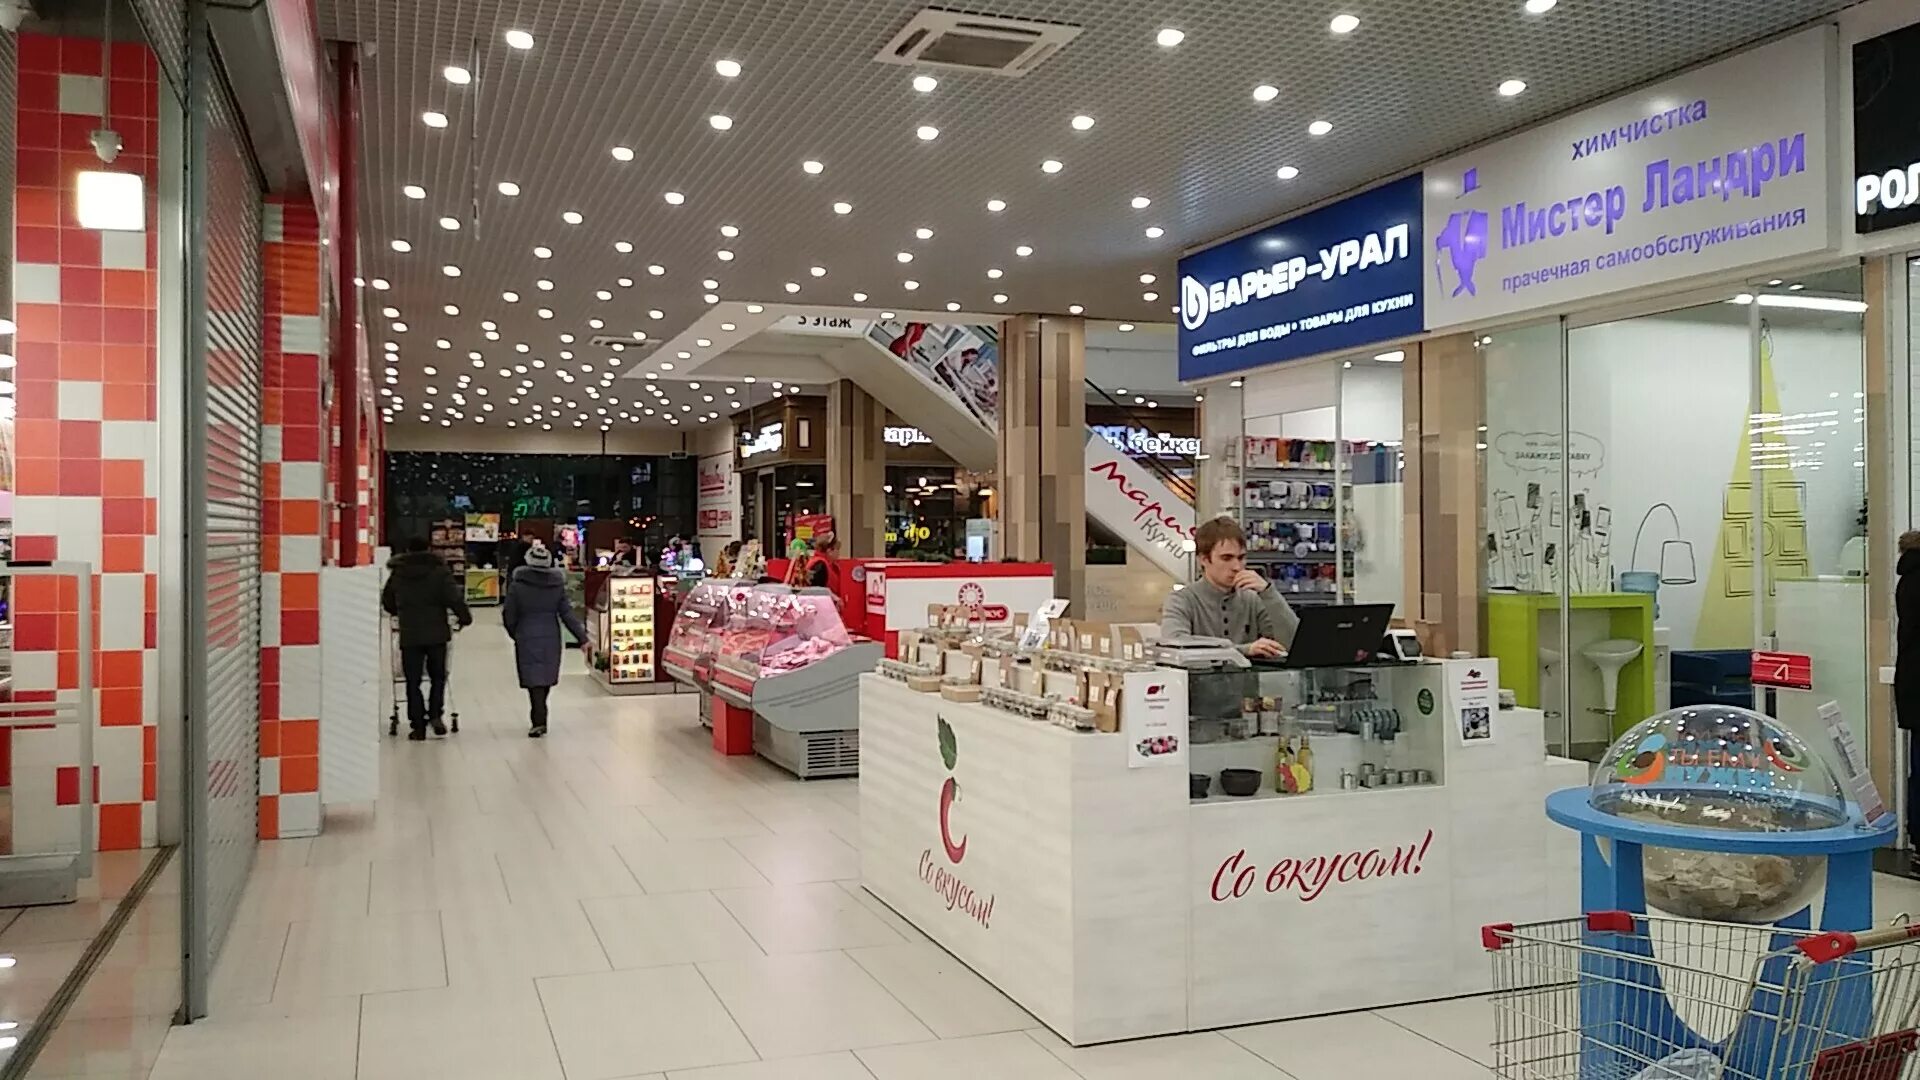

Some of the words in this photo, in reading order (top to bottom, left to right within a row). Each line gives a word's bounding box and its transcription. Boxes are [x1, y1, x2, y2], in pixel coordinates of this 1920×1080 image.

[1572, 99, 1707, 160] химчистка
[1502, 185, 1626, 249] Мистер
[1642, 133, 1806, 213] Ландри
[1208, 223, 1409, 313] БАРЬЕР-УРАЛ
[1502, 258, 1590, 293] прачечная
[1596, 208, 1806, 271] самообслуживания
[1192, 336, 1237, 356] ФИЛЬТРЫ
[1237, 331, 1259, 348] ДЛЯ
[1260, 323, 1291, 341] ВОДЫ
[1299, 310, 1344, 331] ТОВАРЫ
[1344, 304, 1370, 323] ДЛЯ
[1371, 293, 1414, 315] КУХНИ
[919, 848, 934, 884] Со
[934, 867, 996, 930] вкусом!
[1211, 848, 1257, 903] Со
[1265, 829, 1433, 903] вкусом!
